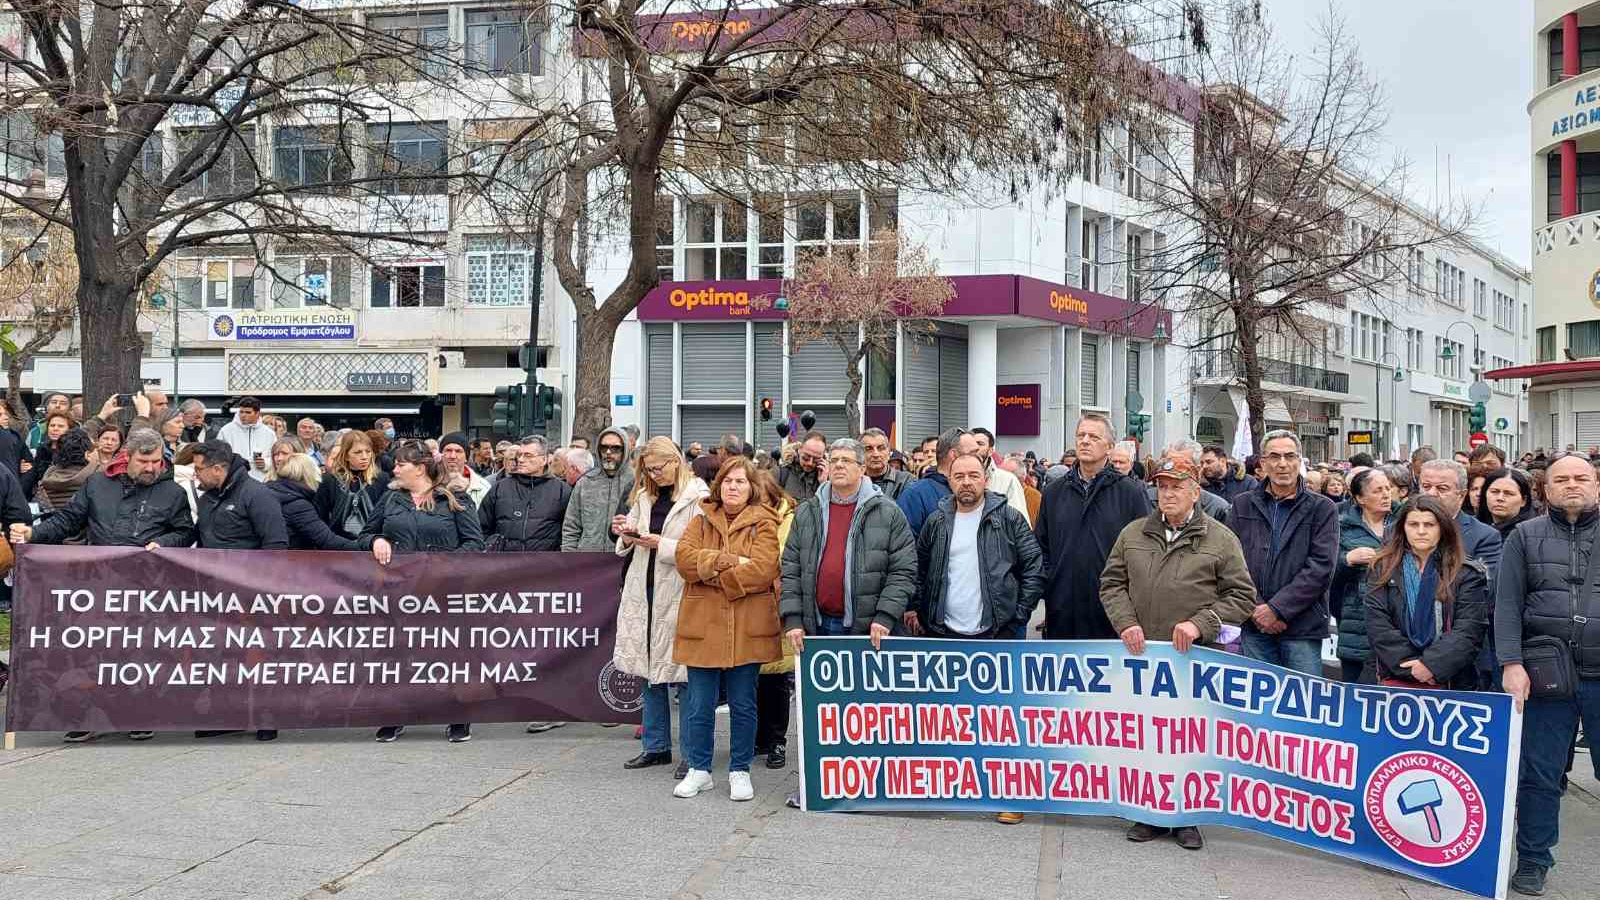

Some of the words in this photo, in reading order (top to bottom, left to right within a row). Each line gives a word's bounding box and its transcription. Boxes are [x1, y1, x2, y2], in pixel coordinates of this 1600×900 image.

[1575, 84, 1600, 106] ΛΕ
[670, 287, 749, 311] Optima
[729, 305, 751, 315] bank
[1050, 290, 1088, 314] Optima
[241, 314, 308, 325] ΠΑΤΡΙΩΤΙΚΗ
[311, 314, 351, 325] ΕΝΩΣΗ
[241, 327, 289, 337] Πρόδρομος
[349, 374, 408, 385] CAVALLO
[998, 395, 1032, 406] Optima
[50, 589, 95, 613] ΤΟ
[104, 590, 244, 615] ΕΓΚΛΗΜΑ
[250, 593, 325, 616] ΑΥΤΟ
[332, 594, 390, 615] ΔΕΝ
[398, 594, 441, 615] ΘΑ
[447, 592, 583, 615] ΞΕΧΑΣΤΕΙ!
[29, 626, 51, 649] Η
[61, 626, 143, 649] ΟΡΓΗ
[153, 626, 216, 649] ΜΑΣ
[225, 626, 266, 649] ΝΑ
[272, 626, 395, 649] ΤΣΑΚΙΣΕΙ
[402, 626, 460, 649] ΤΗΝ
[470, 626, 600, 649] ΠΟΛΙΤΙΚΗ
[97, 662, 162, 686] ΠΟΥ
[167, 662, 228, 686] ΔΕΝ
[237, 662, 355, 686] ΜΕΤΡΑΕΙ
[363, 661, 401, 685] ΤΗ
[409, 661, 470, 685] ΖΩΗ
[479, 661, 538, 684] ΜΑΣ
[811, 650, 853, 691] ΟΙ
[864, 651, 1012, 693] ΝΕΚΡΟΙ
[1022, 654, 1112, 695] ΜΑΣ
[1122, 656, 1181, 700] ΤΑ
[1190, 660, 1345, 727] ΚΕΡΔΗ
[1355, 688, 1491, 754] ΤΟΥΣ
[819, 704, 840, 744] Η
[844, 703, 913, 744] ΟΡΓΗ
[917, 703, 975, 745] ΜΑΣ
[978, 704, 1020, 746] ΝΑ
[1021, 707, 1146, 751] ΤΣΑΚΙΣΕΙ
[1150, 714, 1208, 756] ΤΗΝ
[1214, 718, 1358, 790] ΠΟΛΙΤΙΚΗ
[1431, 759, 1476, 802] ΚΕΝΤΡΟ
[820, 756, 881, 799] ΠΟΥ
[885, 757, 982, 799] ΜΕΤΡΑ
[983, 758, 1045, 799] ΤΗΝ
[1049, 760, 1111, 802] ΖΩΗ
[1117, 765, 1178, 813] ΜΑΣ
[1182, 770, 1223, 813] ΩΣ
[1229, 773, 1356, 844] ΚΟΣΤΟΣ
[1441, 820, 1480, 860] ΛΑΡΙΣΑΣ
